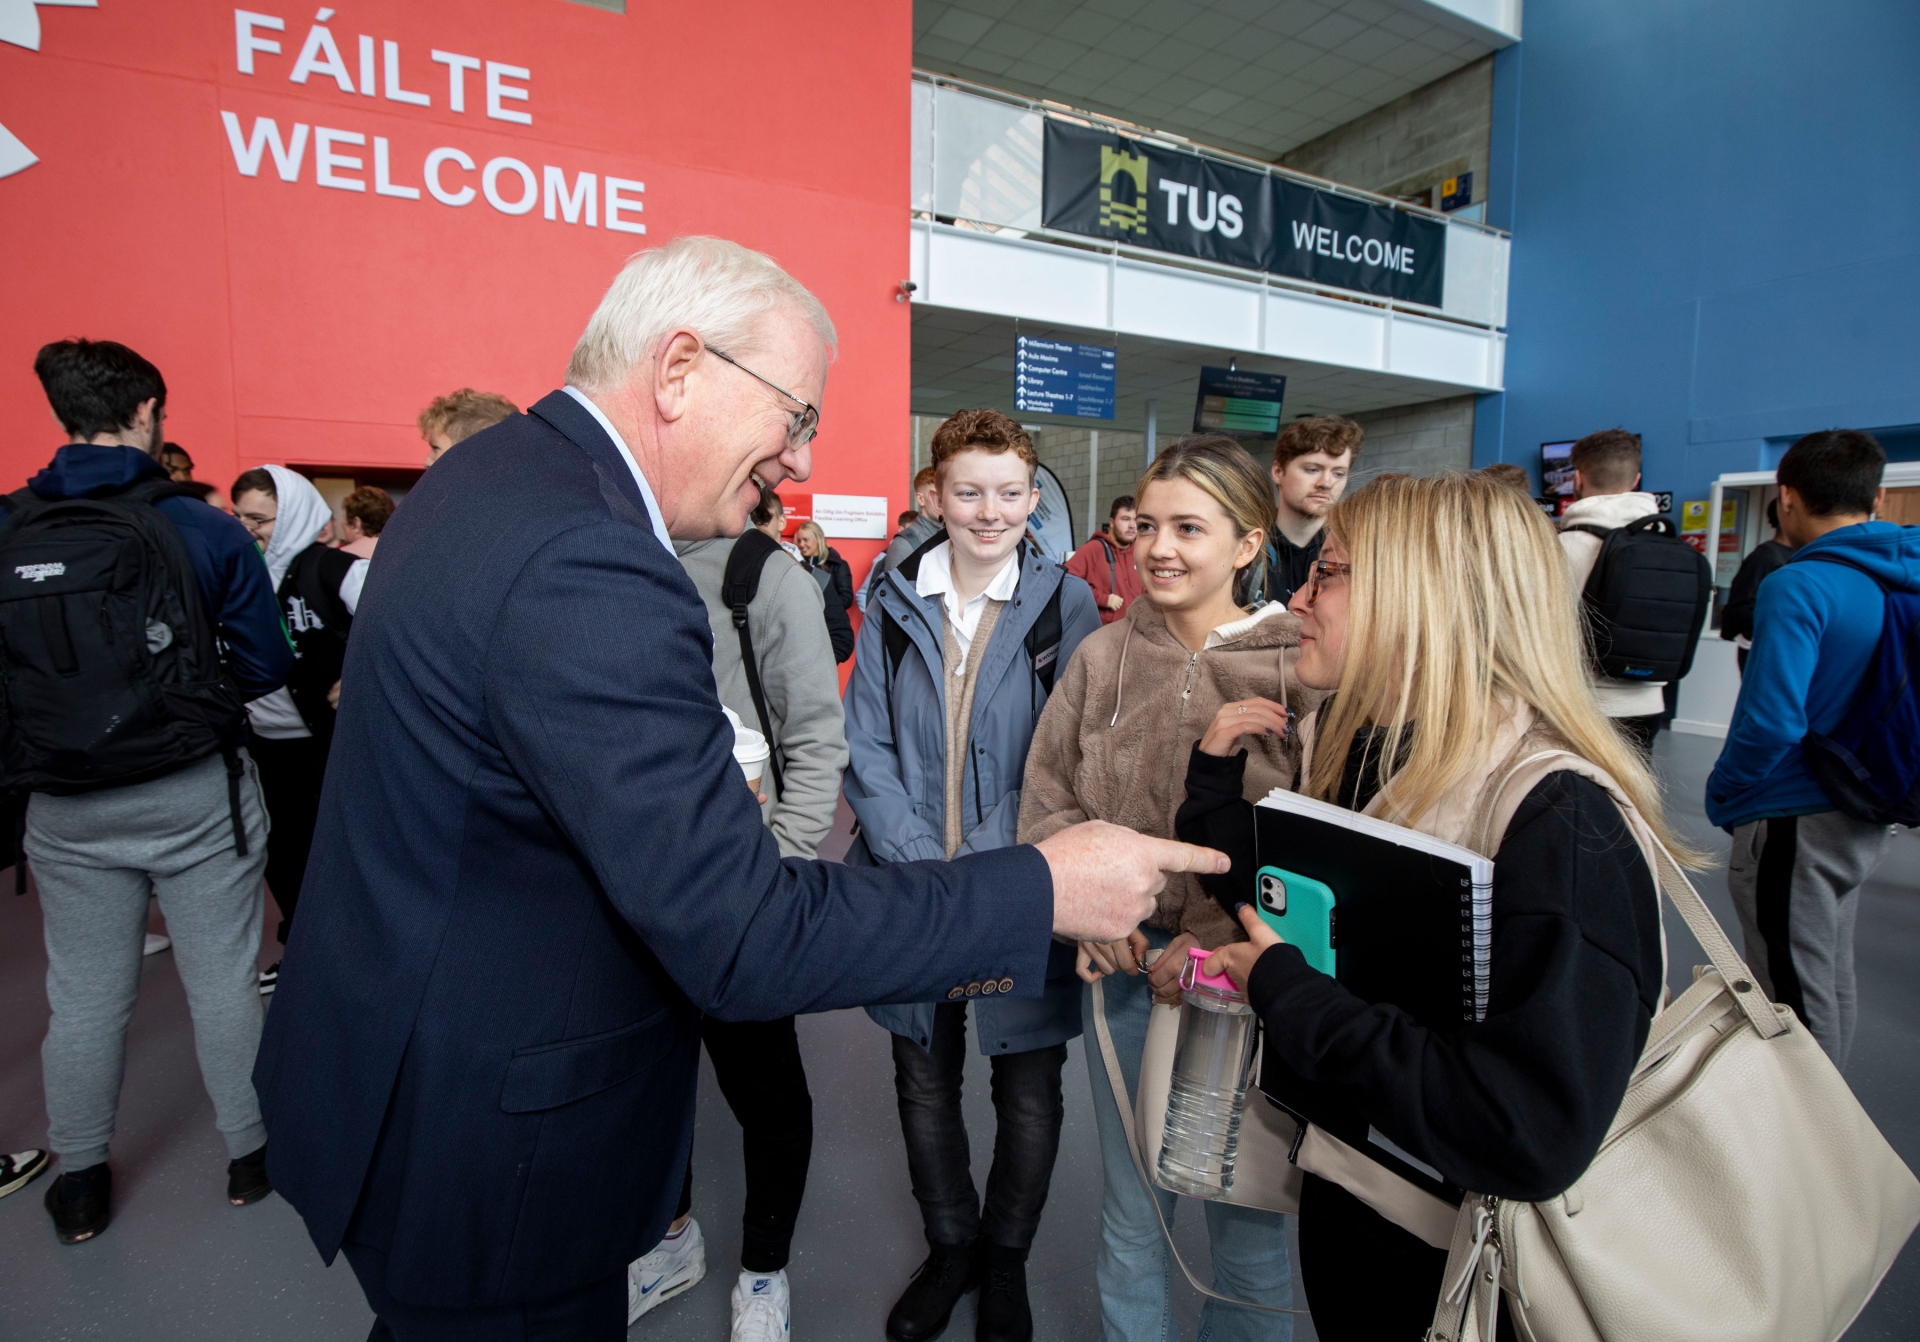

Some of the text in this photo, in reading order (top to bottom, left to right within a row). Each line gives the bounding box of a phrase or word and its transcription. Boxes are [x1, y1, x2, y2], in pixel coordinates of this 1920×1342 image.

[234, 7, 533, 126] FÁILTE
[220, 109, 647, 236] WELCOME
[1158, 178, 1244, 240] TUS
[1291, 219, 1416, 276] WELCOME
[1028, 340, 1073, 352] Millennium Theatre
[1028, 365, 1068, 376] Computer Centre
[1027, 377, 1044, 386] Library
[1027, 390, 1074, 401] Lecture Theatres 1-7
[1027, 399, 1050, 407] Workshops
